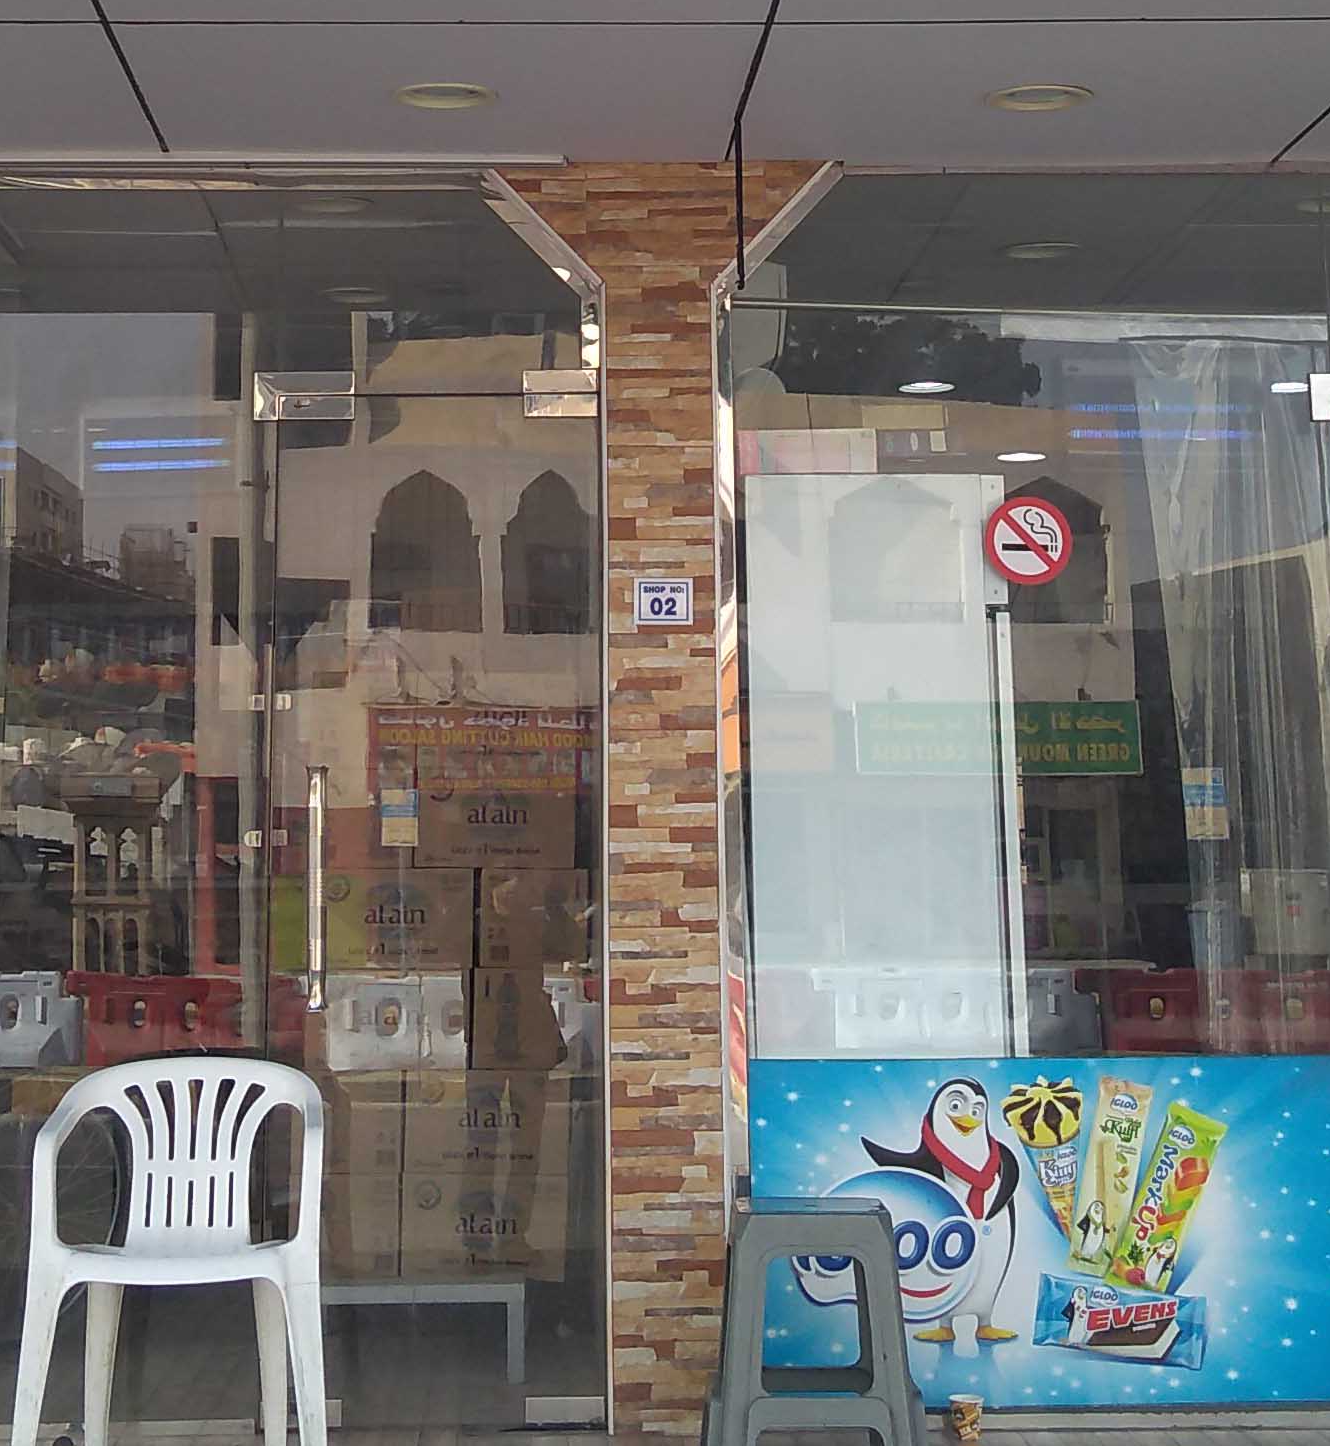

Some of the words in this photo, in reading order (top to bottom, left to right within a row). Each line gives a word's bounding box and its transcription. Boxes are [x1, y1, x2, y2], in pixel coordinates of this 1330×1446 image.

[642, 585, 666, 594] SHOP
[650, 597, 677, 616] 02
[1110, 1097, 1139, 1111] IGLOO
[1089, 1289, 1119, 1302] IGLOO
[1086, 1300, 1178, 1331] EVENS
